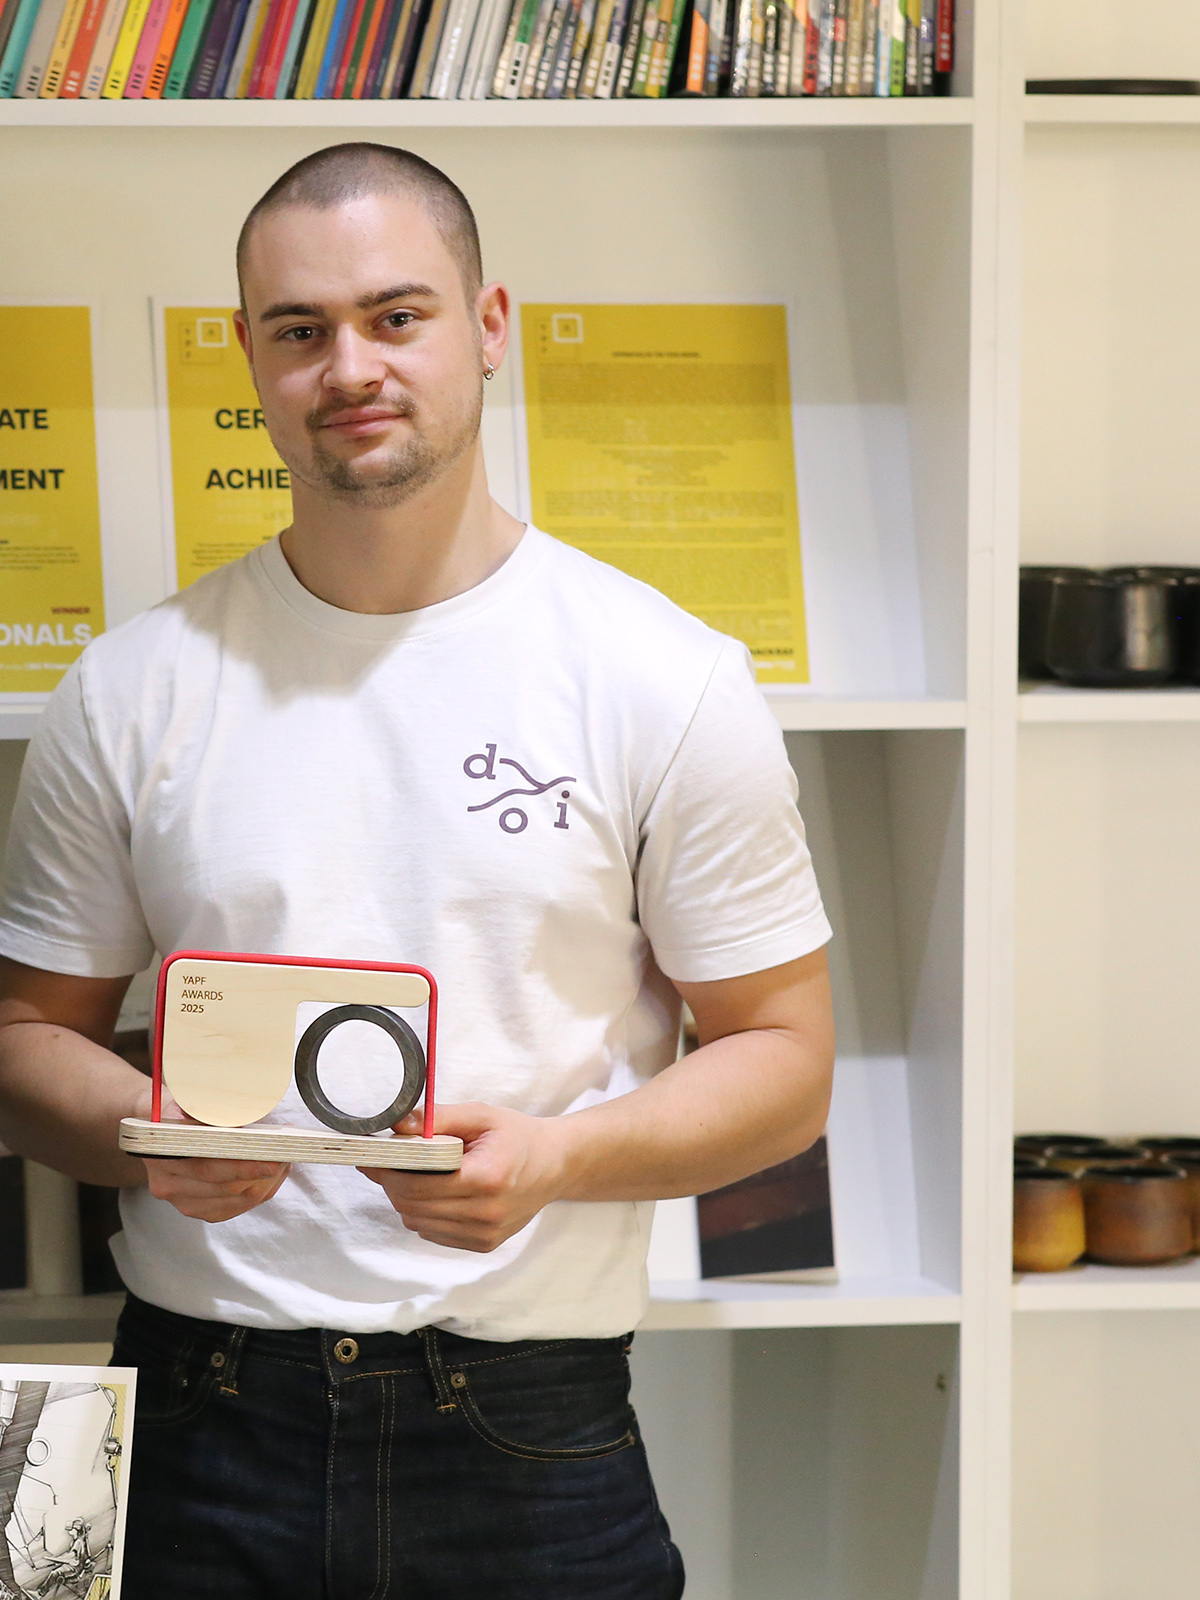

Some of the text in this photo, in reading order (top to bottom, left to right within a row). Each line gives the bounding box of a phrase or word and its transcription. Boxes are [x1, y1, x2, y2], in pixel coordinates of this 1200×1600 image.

[182, 976, 207, 985] YAPF
[181, 989, 224, 1001] AWARDS
[181, 1003, 204, 1013] 2025
